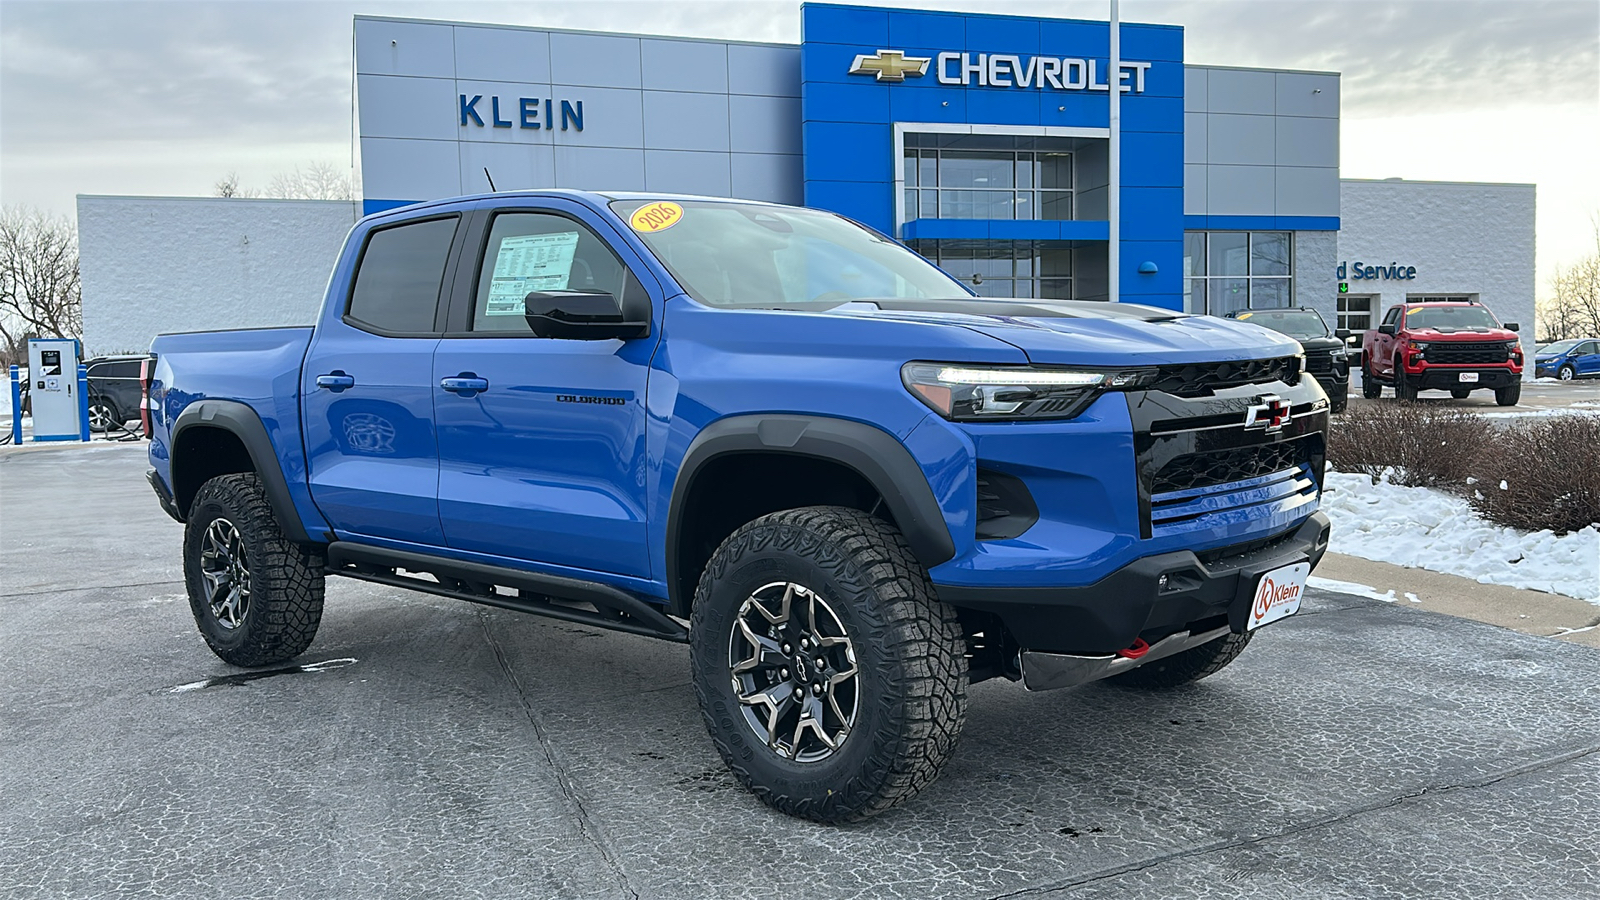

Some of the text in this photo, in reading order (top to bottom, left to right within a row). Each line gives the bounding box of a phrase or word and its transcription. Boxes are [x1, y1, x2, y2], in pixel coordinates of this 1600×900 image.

[938, 51, 1151, 92] CHEVROLET
[459, 94, 584, 132] KLEIN
[638, 203, 676, 229] 2026
[1352, 261, 1417, 280] Service
[556, 394, 626, 406] COLORADO
[1273, 581, 1300, 603] Klein
[703, 608, 753, 762] GOODYEAR
